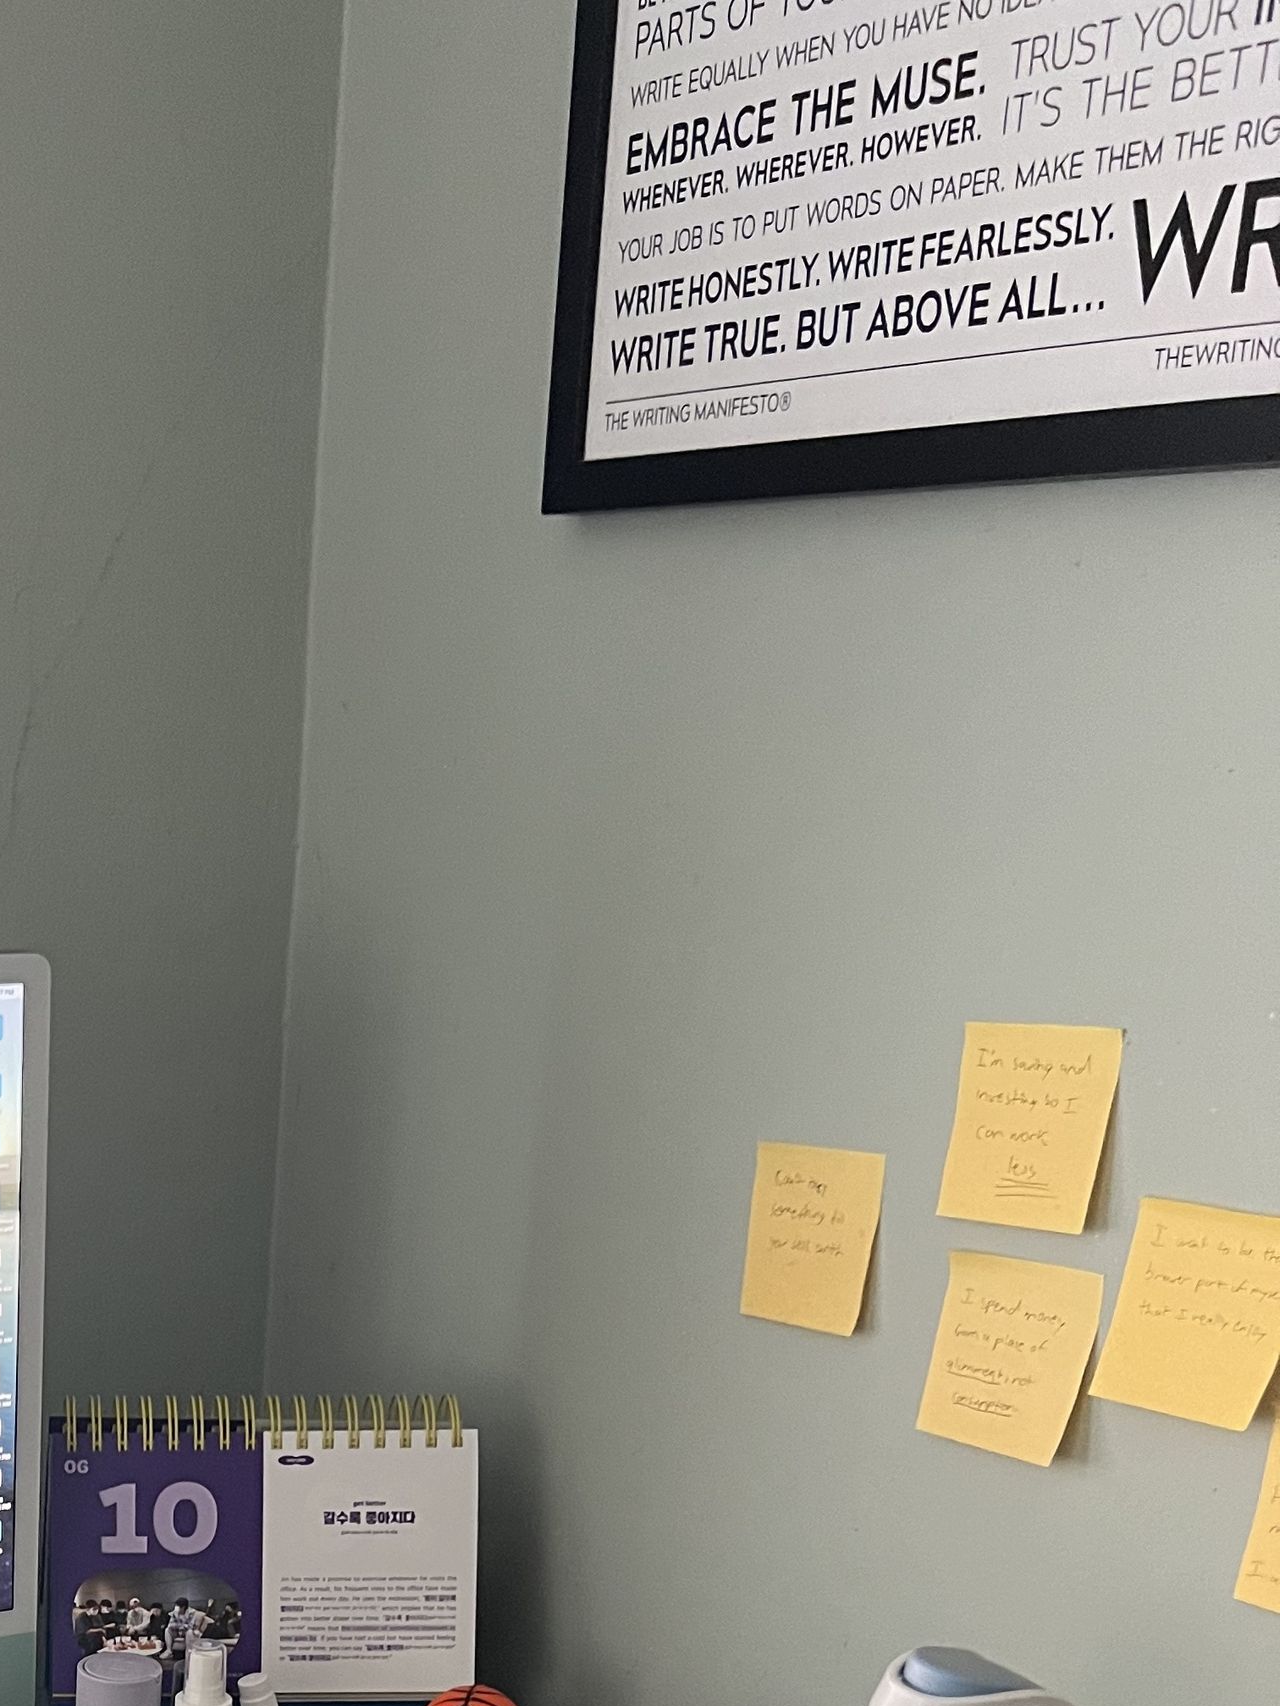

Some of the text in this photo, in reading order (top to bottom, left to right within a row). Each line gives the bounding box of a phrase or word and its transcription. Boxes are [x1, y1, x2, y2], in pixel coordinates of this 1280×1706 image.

[631, 72, 683, 107] WRITE
[688, 50, 770, 94] EQUALLY
[776, 32, 836, 69] WHEN
[842, 18, 886, 52] YOU
[893, 2, 950, 41] HAVE
[960, 0, 992, 31] NO
[635, 0, 716, 60] PARTS
[1010, 16, 1123, 80] TRUST
[1134, 0, 1239, 52] YOUR
[626, 50, 985, 176] EMBRACE THE MUSE.
[1002, 86, 1063, 136] IT'S
[1082, 65, 1154, 120] THE
[618, 233, 663, 264] YOUR
[669, 225, 703, 254] JOB
[709, 220, 725, 246] IS
[732, 214, 756, 242] TO
[762, 205, 800, 236] PUT
[807, 189, 882, 227] WORDS
[890, 181, 923, 211] ON
[930, 166, 1005, 205] PAPER.
[1015, 150, 1085, 190] MAKE
[1095, 136, 1165, 175] THEM
[1175, 124, 1226, 162] THE
[623, 115, 982, 215] WHENEVER. WHEREVER. HOWEVER.
[615, 202, 1114, 319] WRITE HONESTLY. WRITE FEARLESSLY.
[611, 272, 1105, 376] WRITE TRUE. BUT ABOVE ALL...
[605, 410, 629, 432] THE
[633, 403, 691, 427] WRITING
[1060, 1054, 1093, 1076] and
[1010, 1129, 1049, 1147] work
[1062, 1096, 1081, 1115] I
[1006, 1154, 1038, 1180] less
[1150, 1223, 1168, 1248] I
[960, 1287, 975, 1305] I
[98, 1481, 218, 1555] 10
